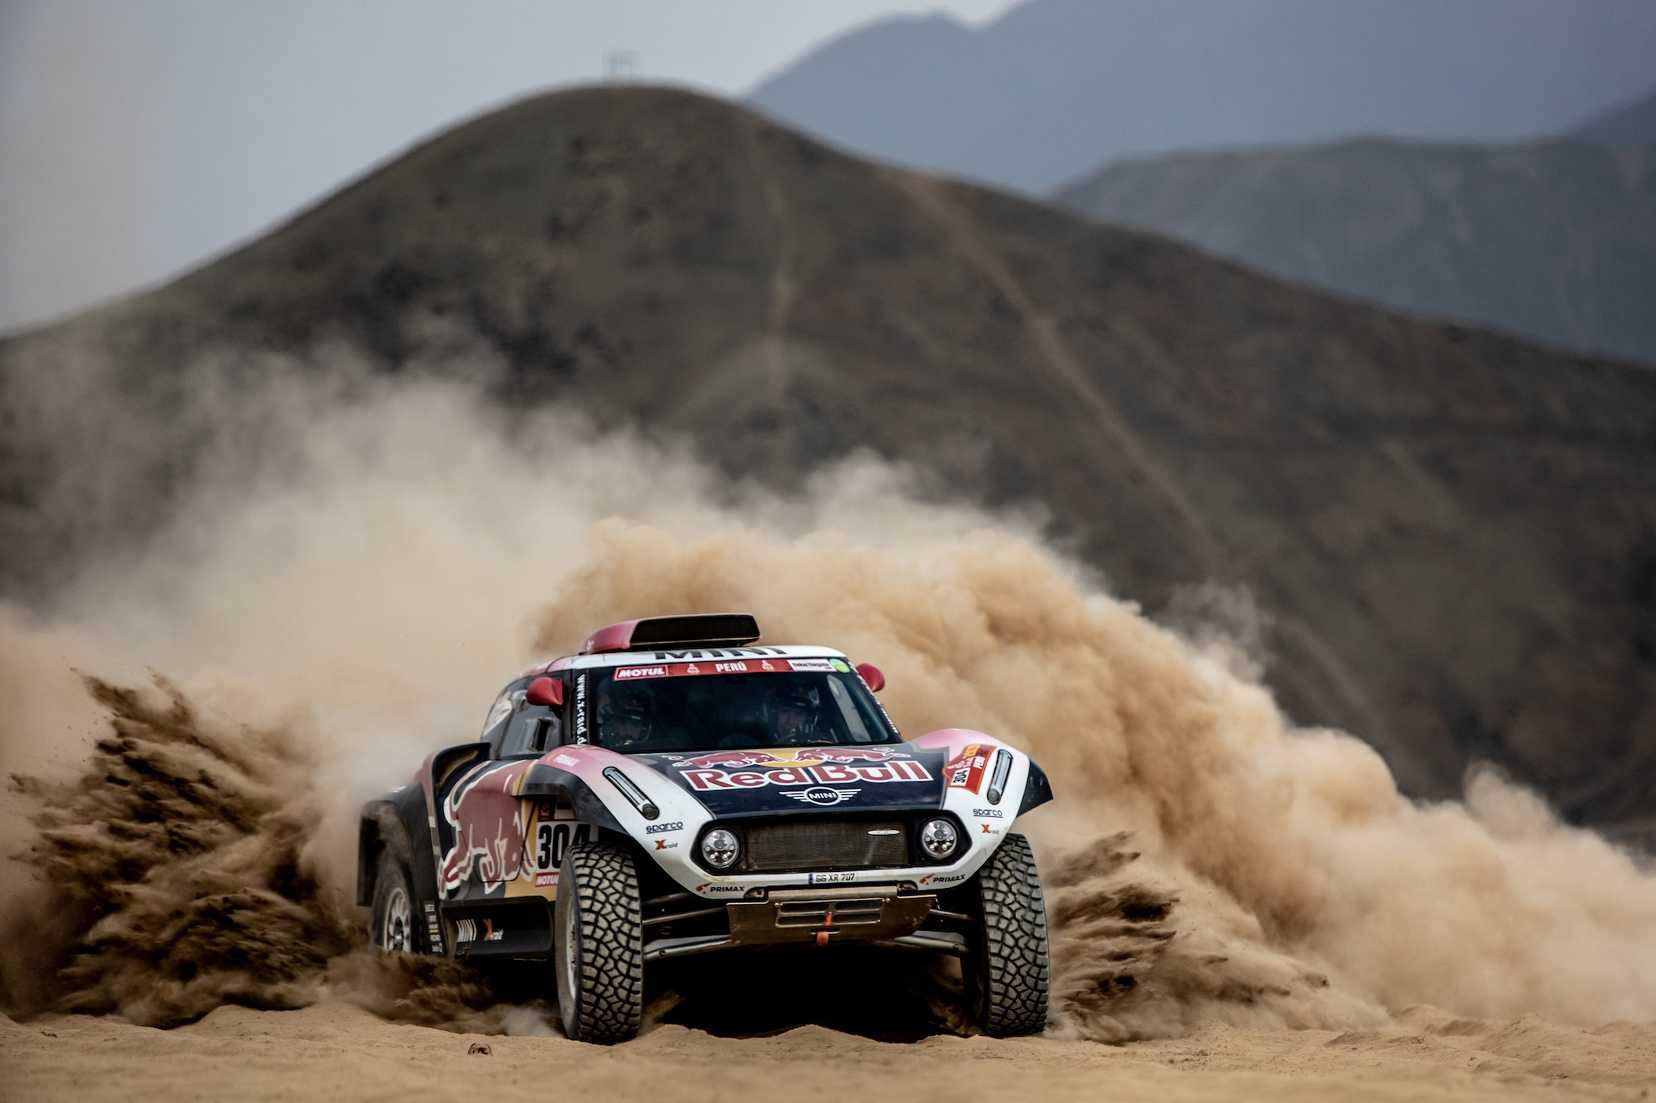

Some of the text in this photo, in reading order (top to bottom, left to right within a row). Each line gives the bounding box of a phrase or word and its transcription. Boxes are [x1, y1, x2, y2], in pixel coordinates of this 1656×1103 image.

[618, 667, 666, 679] MOTUL
[680, 766, 814, 791] Red
[808, 760, 934, 784] Bull
[808, 792, 838, 801] MINI
[973, 808, 1004, 818] sparco
[646, 821, 684, 834] sparco
[932, 874, 966, 883] PRIMAX
